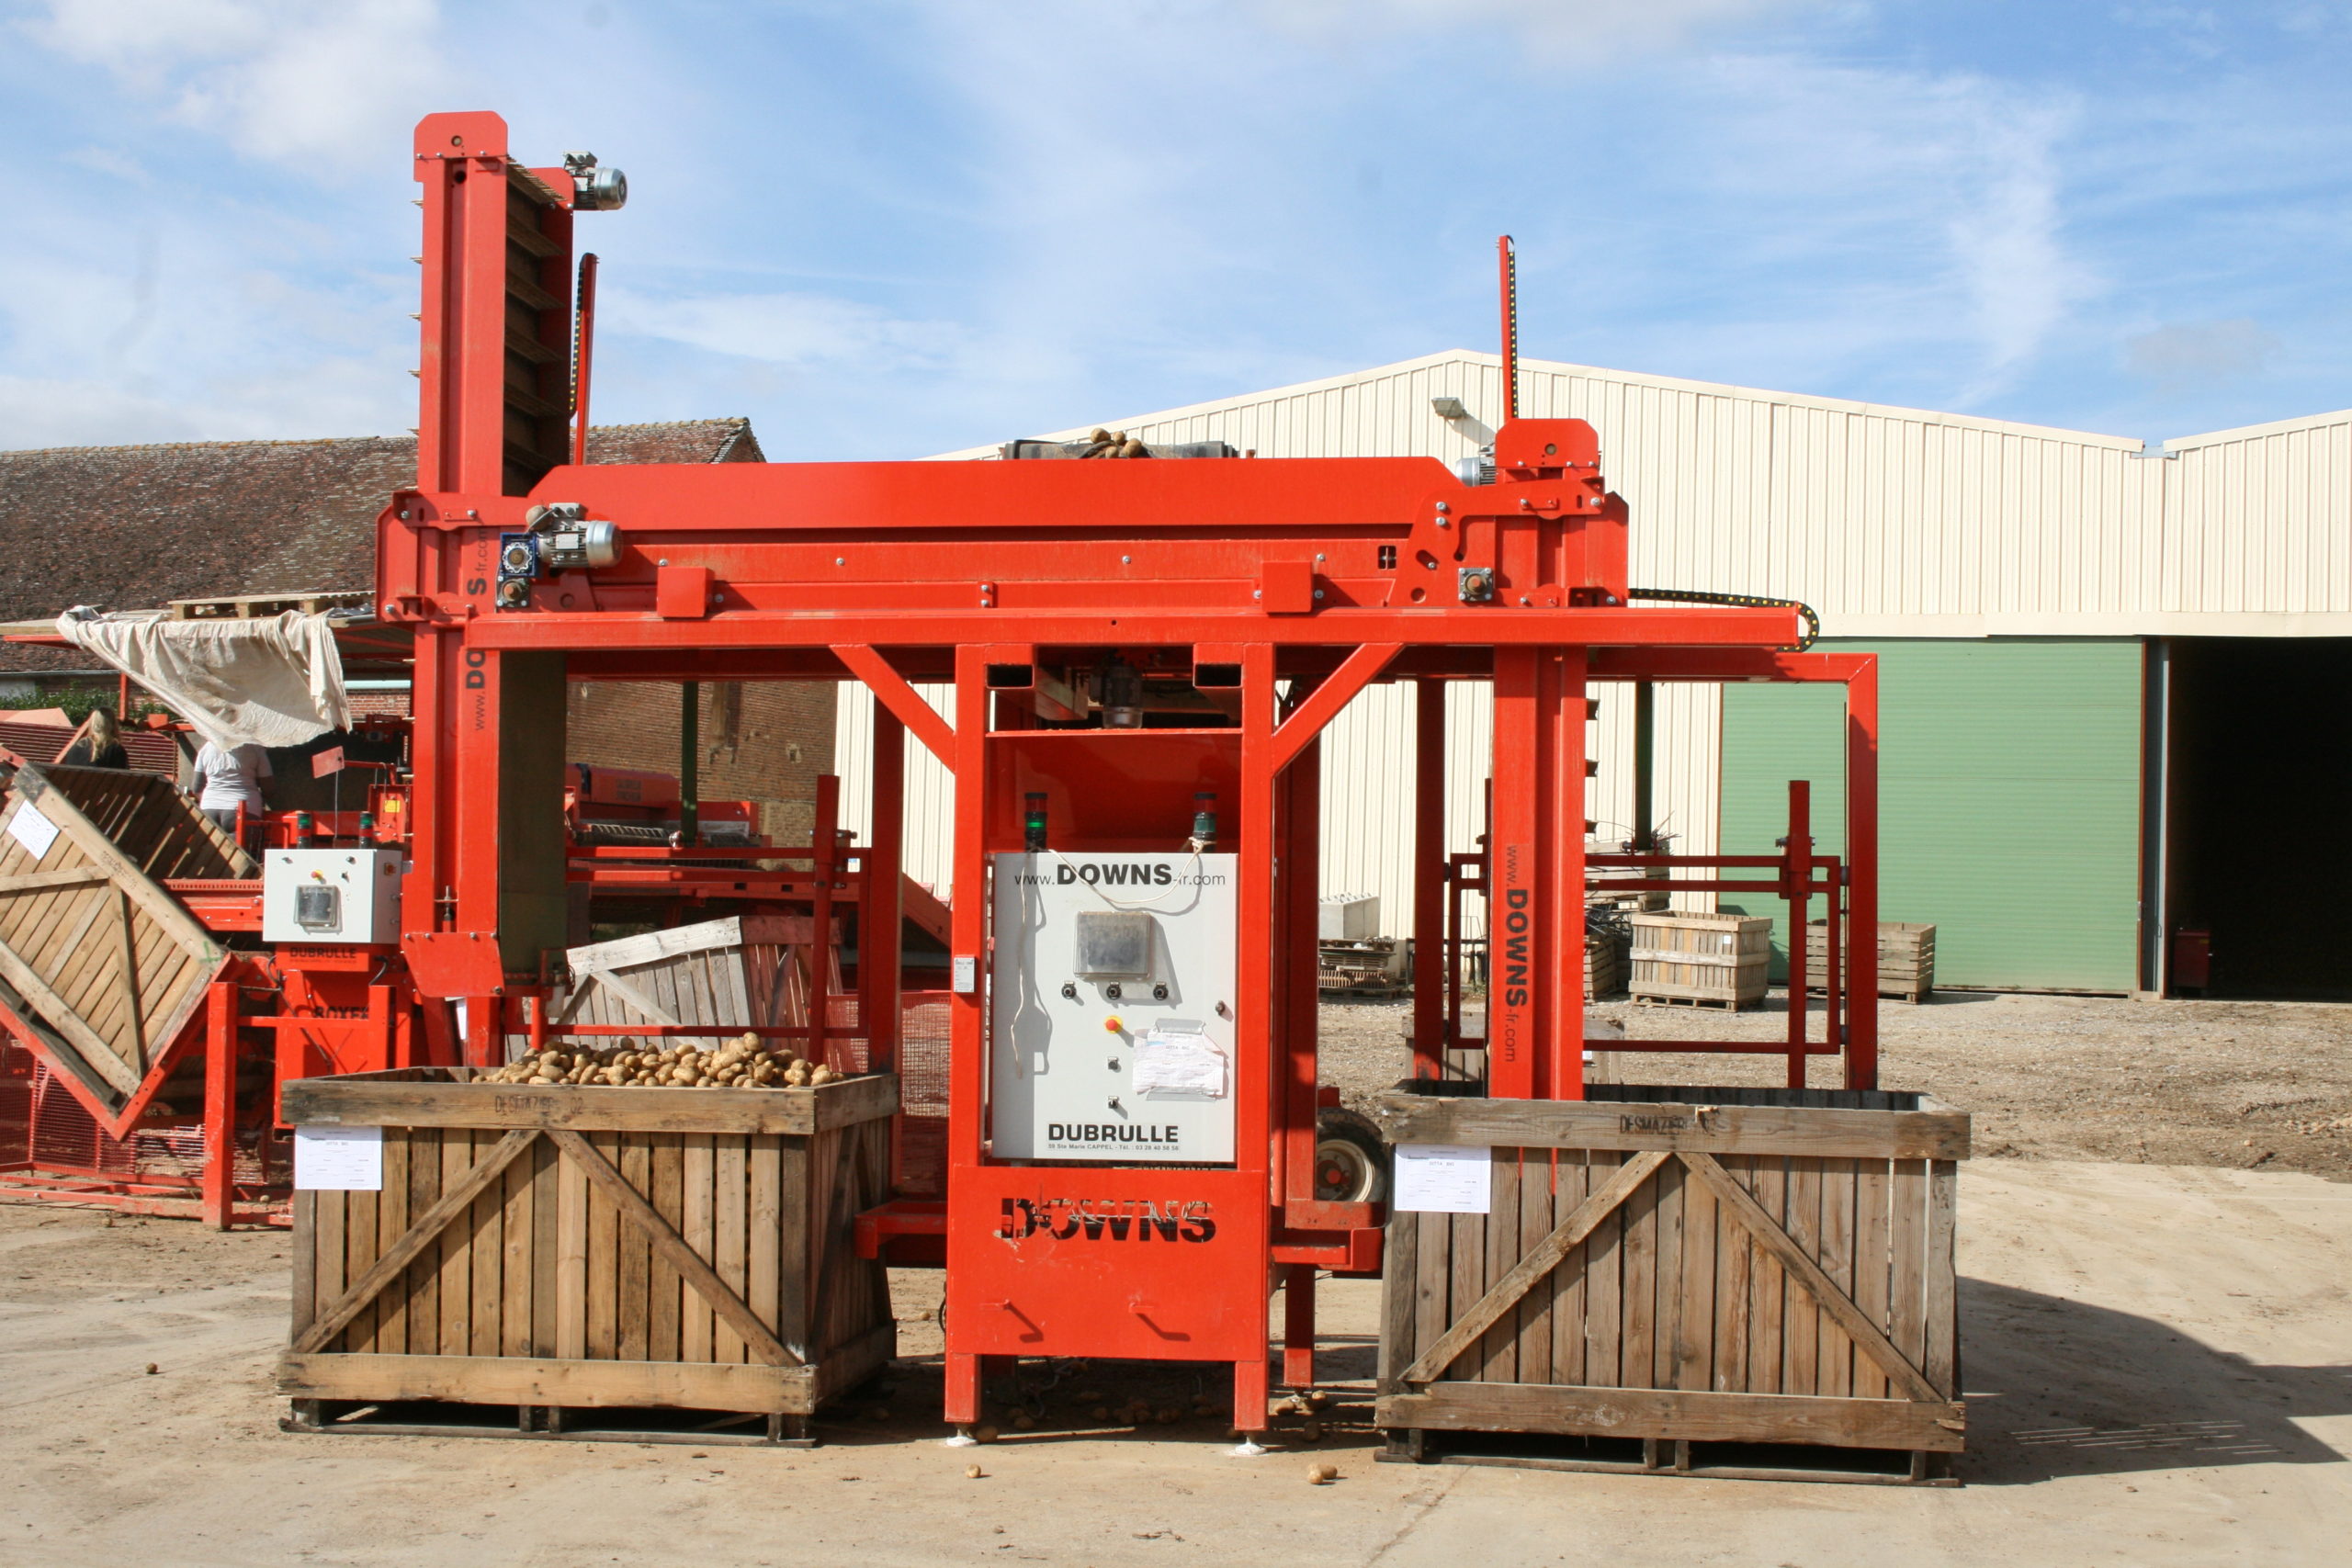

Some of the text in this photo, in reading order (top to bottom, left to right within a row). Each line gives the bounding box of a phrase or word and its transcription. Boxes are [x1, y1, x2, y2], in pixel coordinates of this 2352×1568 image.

[289, 947, 356, 959] DUBRULLE
[1505, 844, 1529, 1063] www.DOWNS-fr.com
[1048, 1123, 1179, 1143] DUBRULLE
[1001, 1198, 1216, 1243] DOWNS
